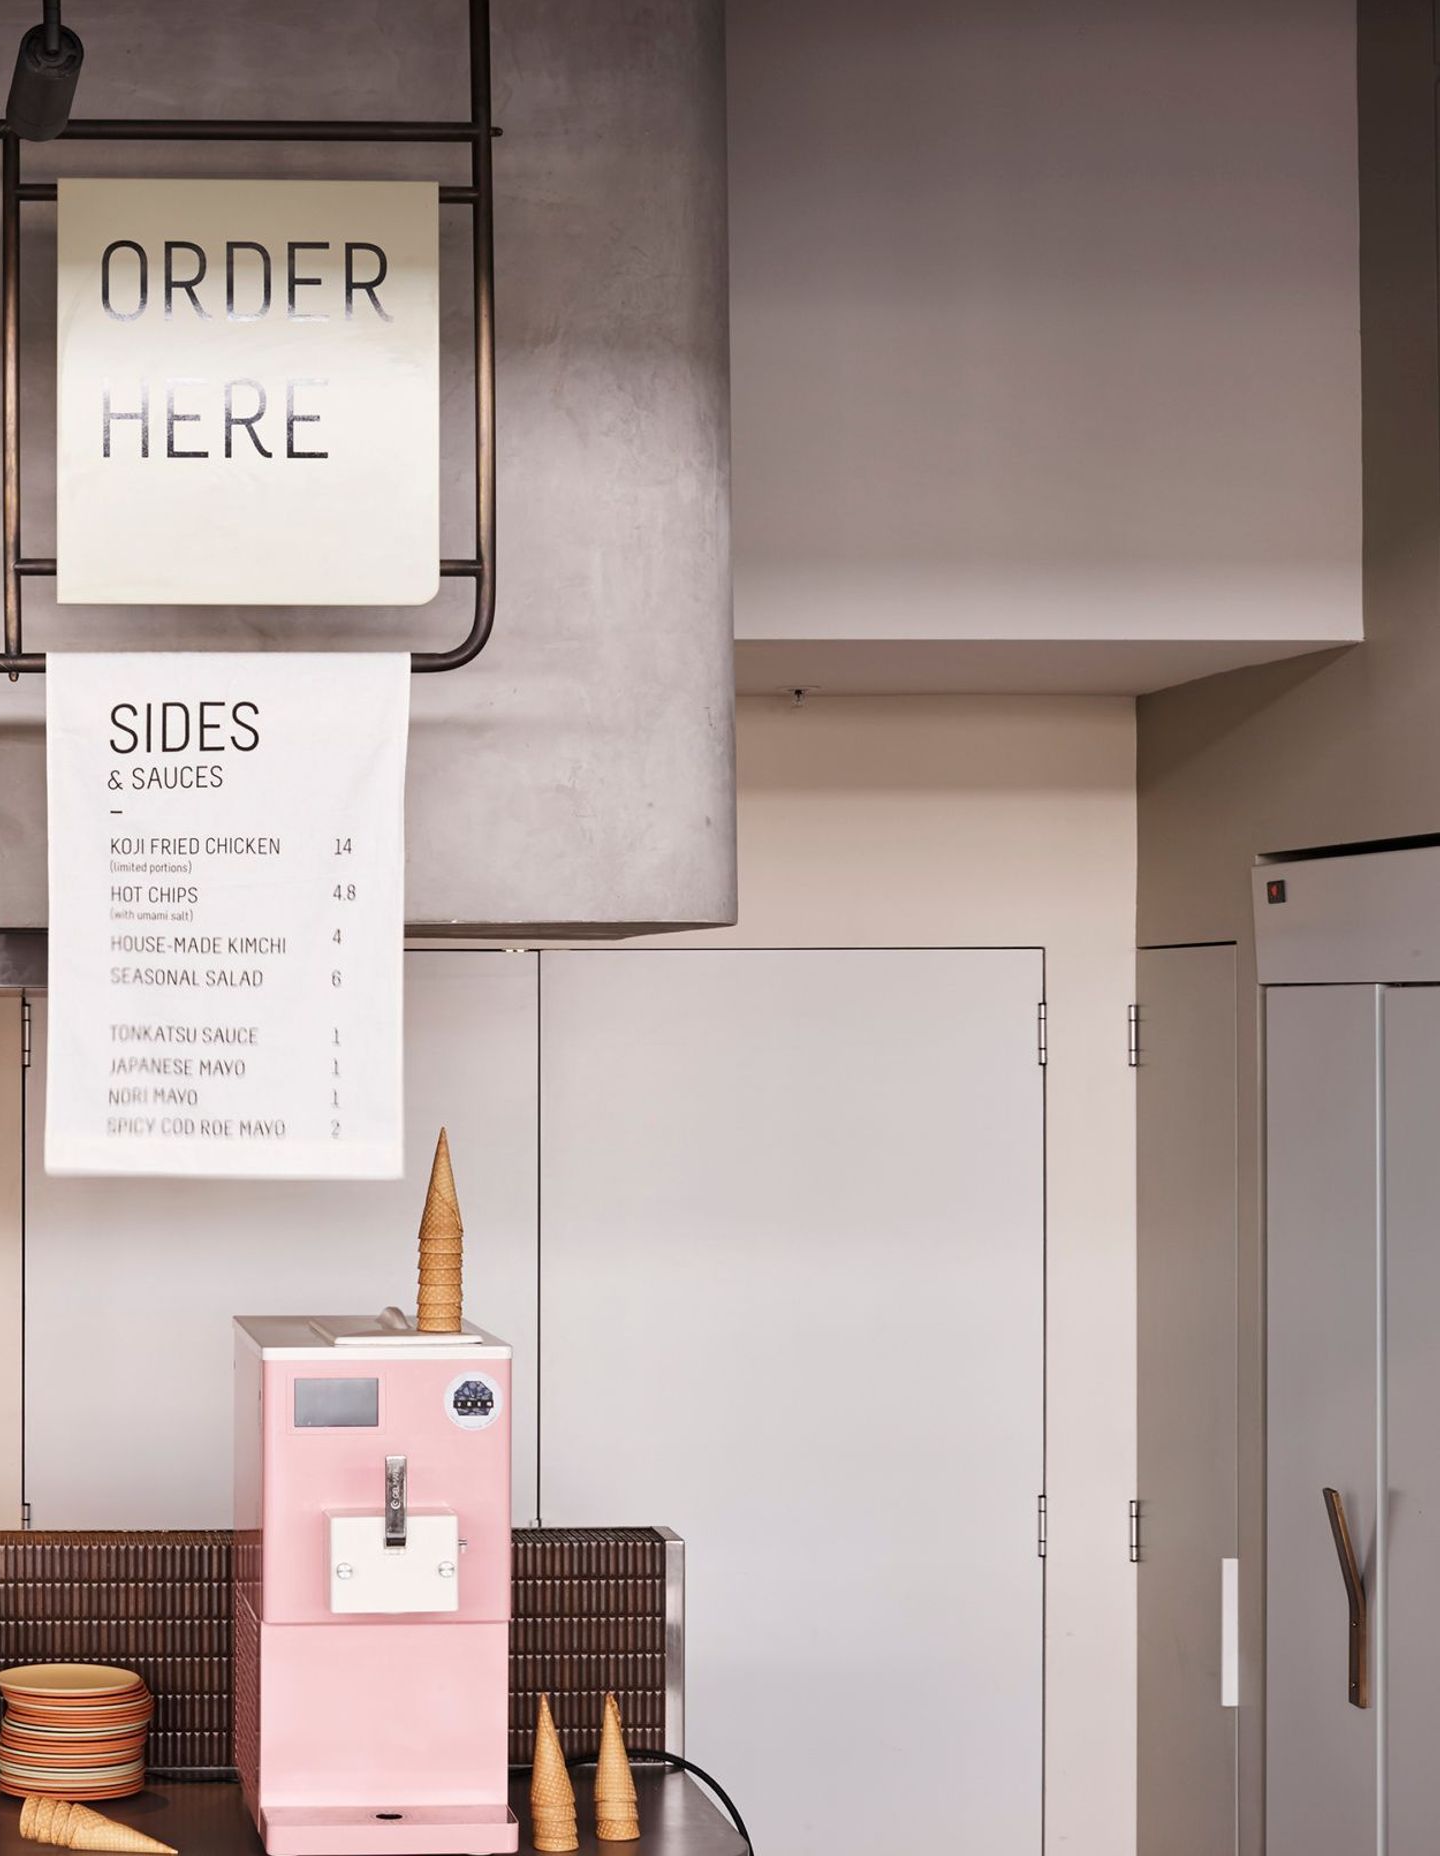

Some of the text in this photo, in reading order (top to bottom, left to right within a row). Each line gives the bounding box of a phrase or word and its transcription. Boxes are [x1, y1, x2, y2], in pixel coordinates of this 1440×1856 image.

[101, 239, 393, 323] ORDER
[101, 377, 329, 459] HERE
[110, 702, 259, 754] SIDES
[108, 765, 222, 790] & SAUCES
[111, 837, 351, 855] KOJI FRIED CHICKEN 14
[110, 860, 192, 875] (limited portions)
[111, 884, 356, 903] HOT CHIPS 4.8
[110, 906, 193, 922] (with umami salt)
[111, 929, 341, 954] HOUSE-MADE KIMCHI 4
[111, 967, 341, 988] SEASONAL SALAD 6
[111, 1024, 341, 1046] TONKATSU SAUCE 1
[111, 1056, 340, 1077] JAPANESE MAYO 1
[109, 1087, 340, 1108] NORI MAYO 1
[106, 1116, 341, 1139] SPICY COD ROE MAYO 2
